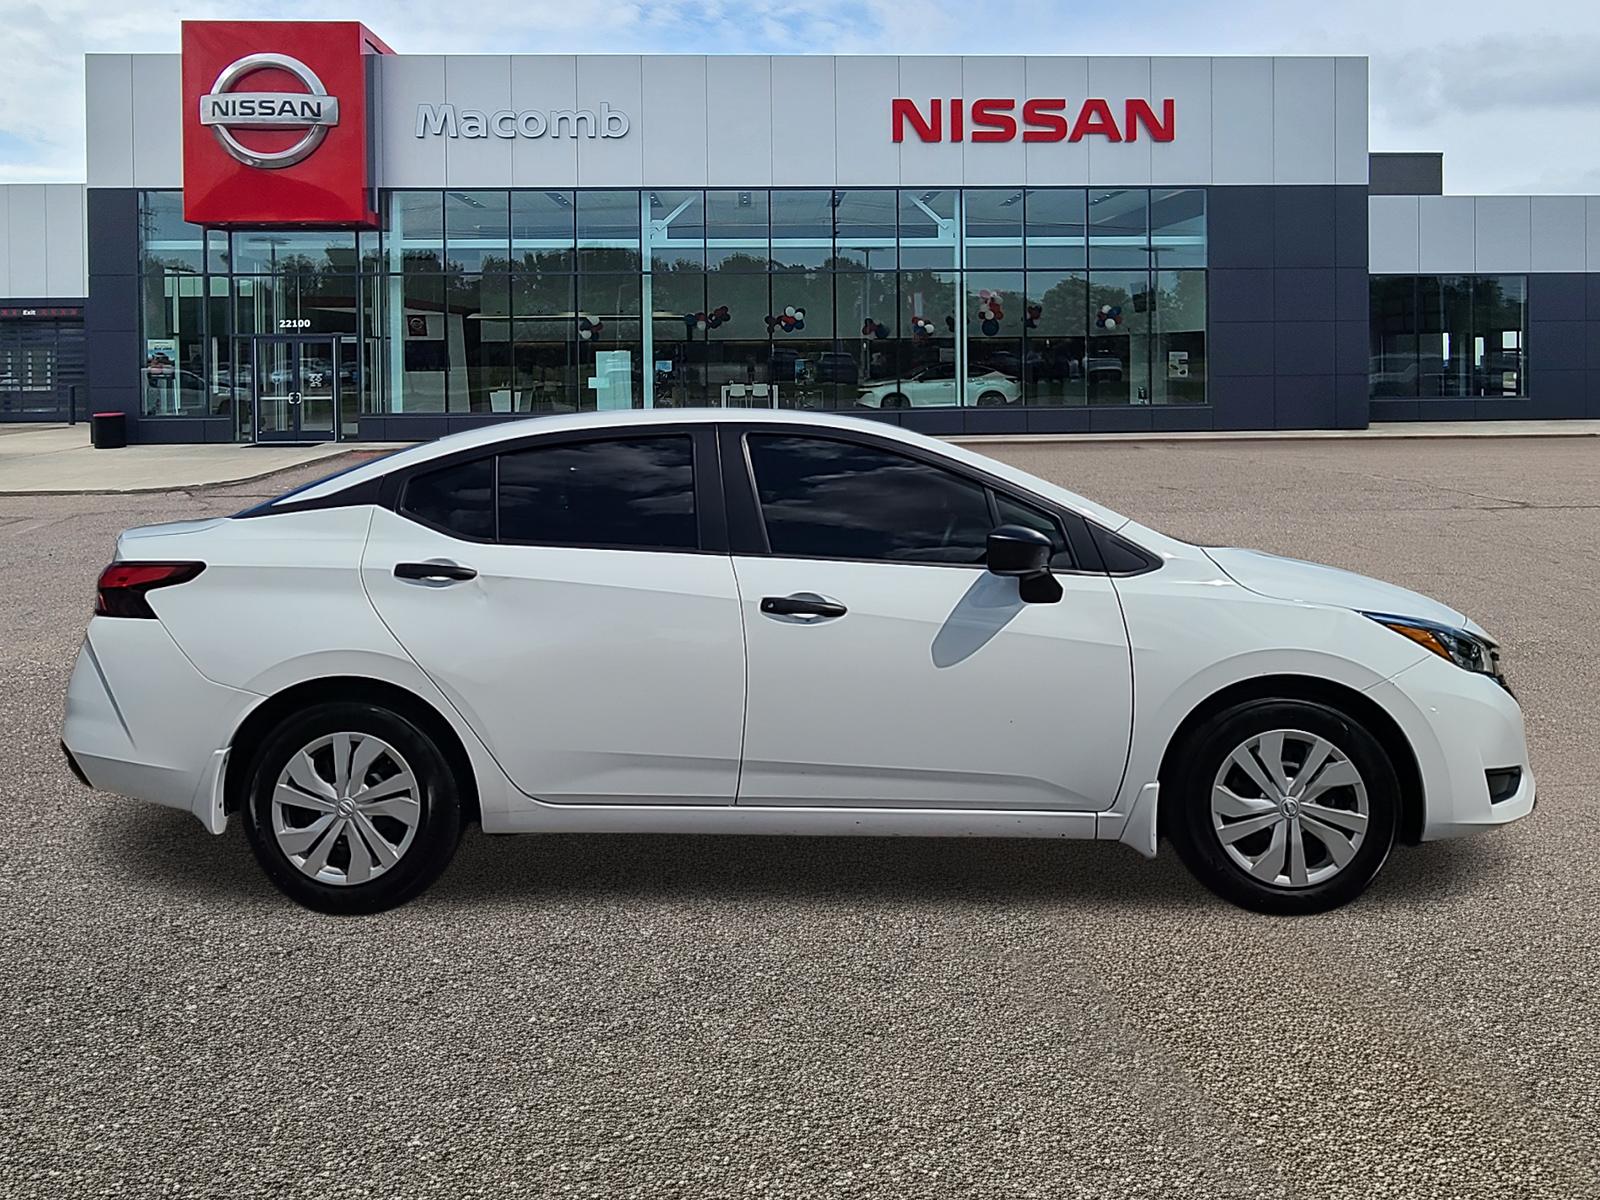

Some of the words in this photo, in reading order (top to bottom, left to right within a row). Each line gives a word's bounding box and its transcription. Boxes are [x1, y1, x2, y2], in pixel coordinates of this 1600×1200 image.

[211, 100, 322, 117] NISSAN
[415, 102, 630, 139] Macomb
[892, 98, 1175, 143] NISSAN
[279, 319, 311, 328] 22100
